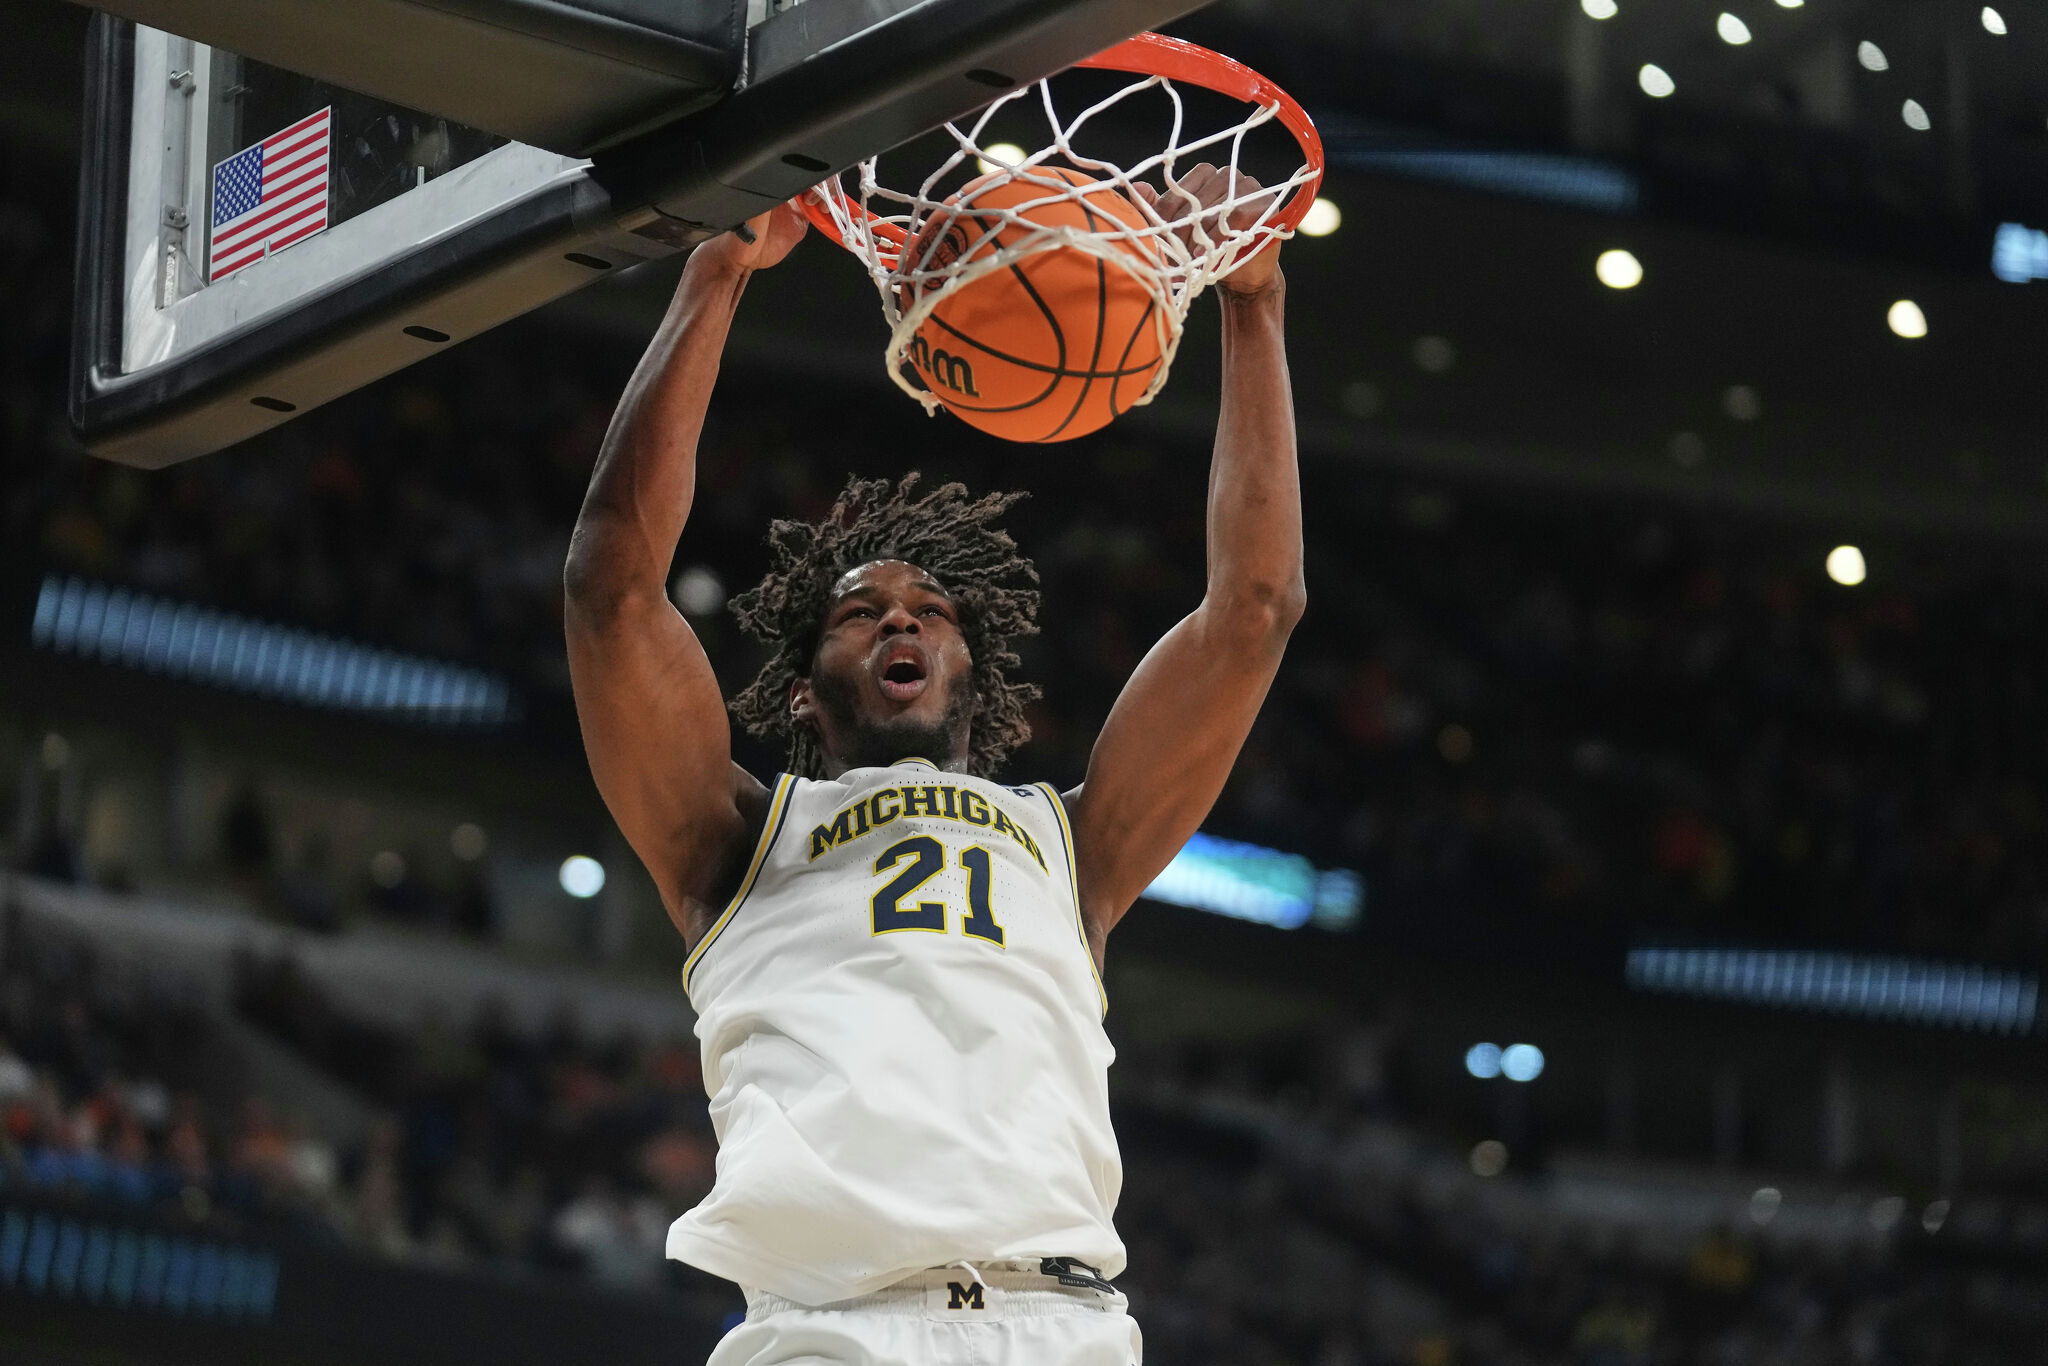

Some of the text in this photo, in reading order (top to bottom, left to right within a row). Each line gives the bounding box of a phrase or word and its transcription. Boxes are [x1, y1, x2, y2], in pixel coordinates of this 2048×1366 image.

[808, 786, 1050, 877] MICHIGAN
[869, 834, 1006, 950] 21
[946, 1281, 985, 1310] M
